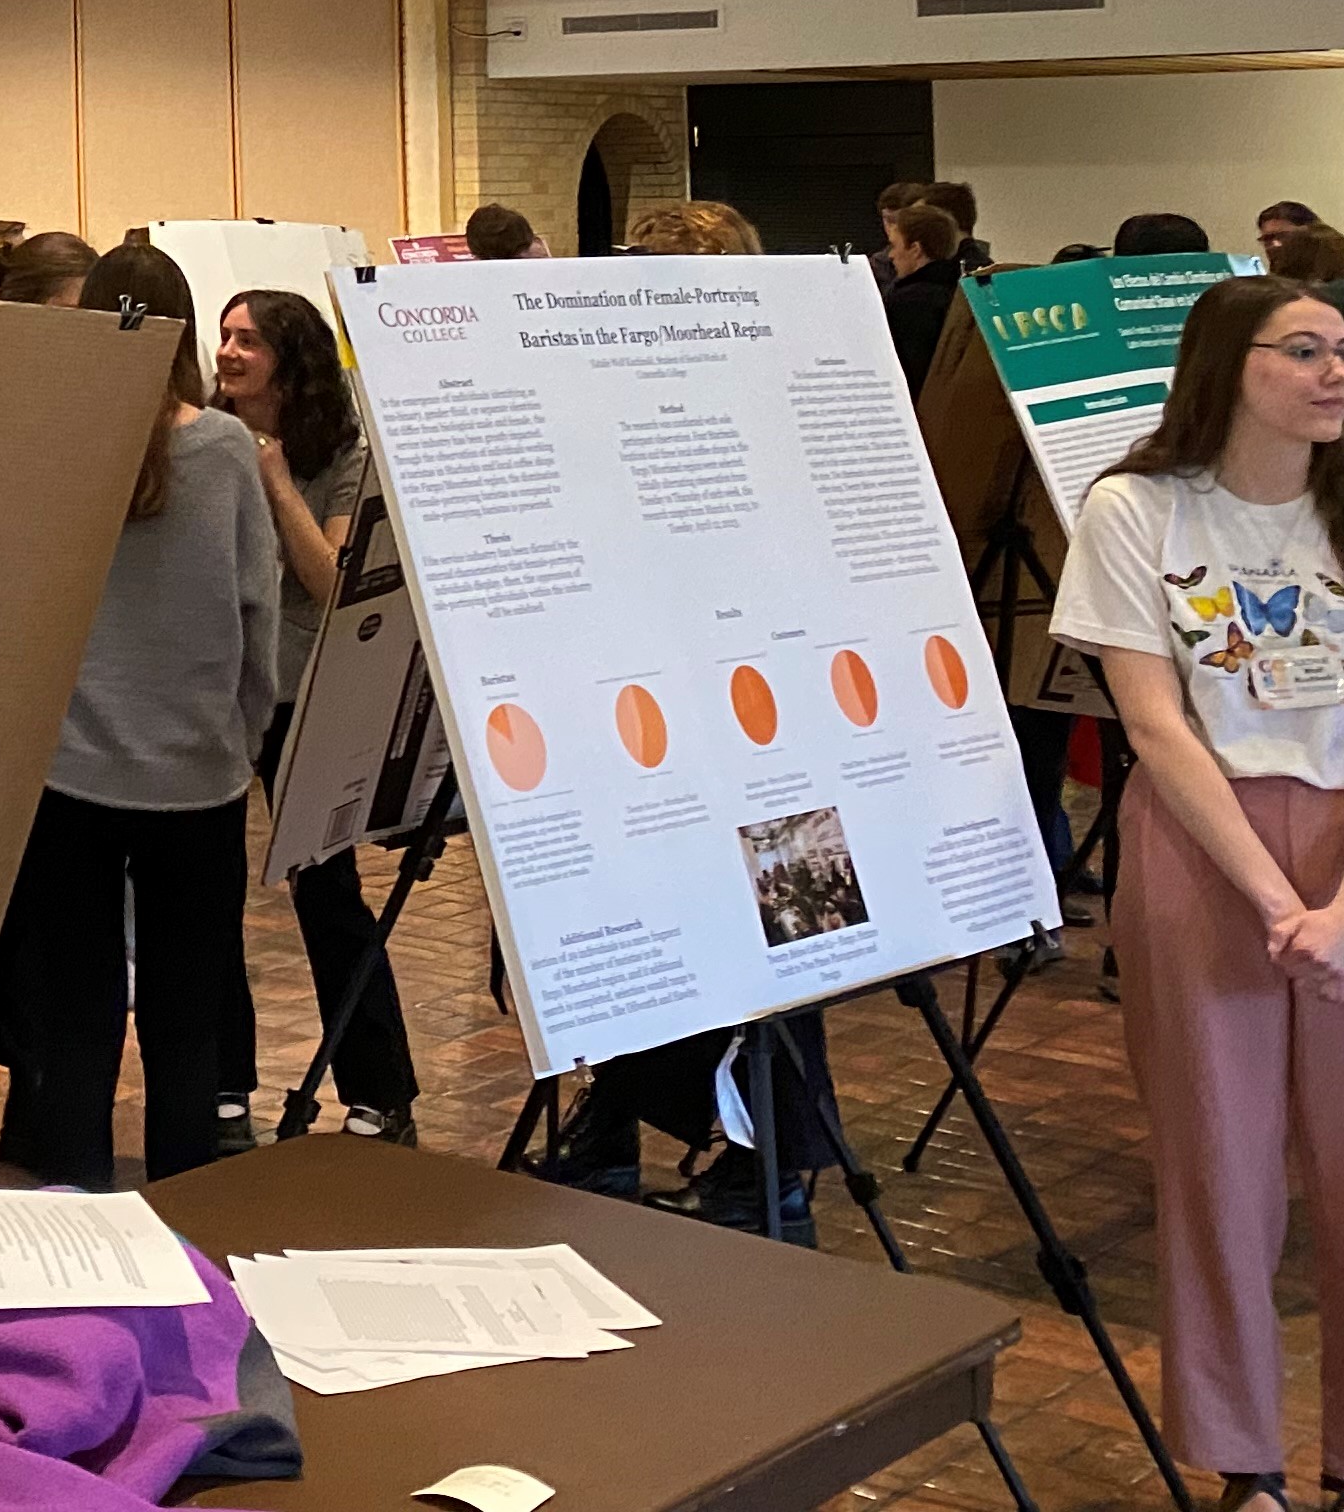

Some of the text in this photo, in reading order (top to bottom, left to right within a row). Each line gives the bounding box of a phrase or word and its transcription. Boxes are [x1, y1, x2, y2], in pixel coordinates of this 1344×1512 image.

[513, 286, 761, 311] The Domination of Female-Portraying
[378, 302, 479, 328] CONCORDIA
[402, 327, 467, 344] COLLEGE
[519, 321, 773, 349] Baristas in the Fargo/Moorhead Region
